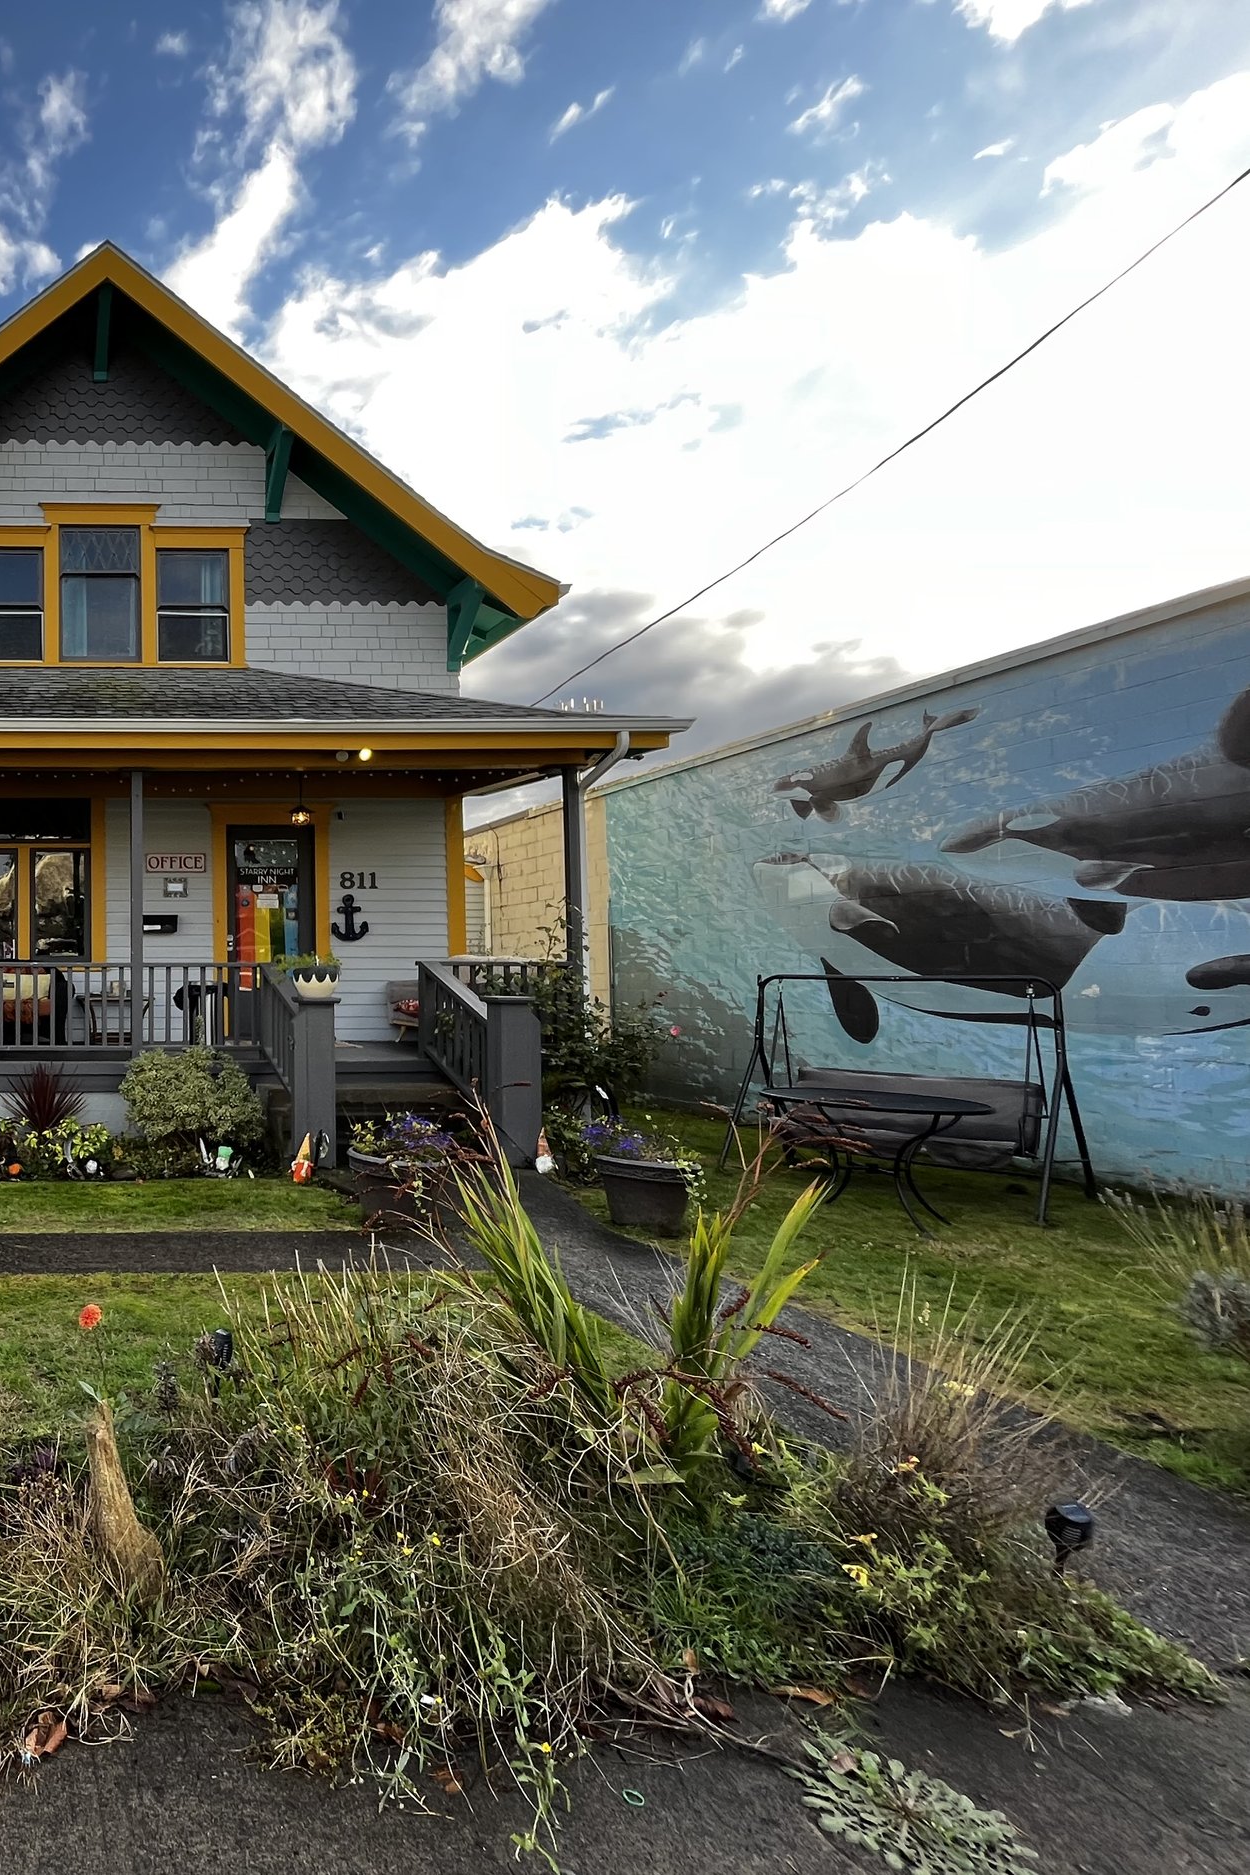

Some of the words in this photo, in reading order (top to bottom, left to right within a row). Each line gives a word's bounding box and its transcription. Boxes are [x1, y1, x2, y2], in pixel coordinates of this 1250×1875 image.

[148, 855, 203, 870] OFFICE
[240, 867, 268, 876] STARRY
[270, 867, 294, 876] NIGHT
[257, 875, 277, 884] INN
[340, 872, 378, 890] 811
